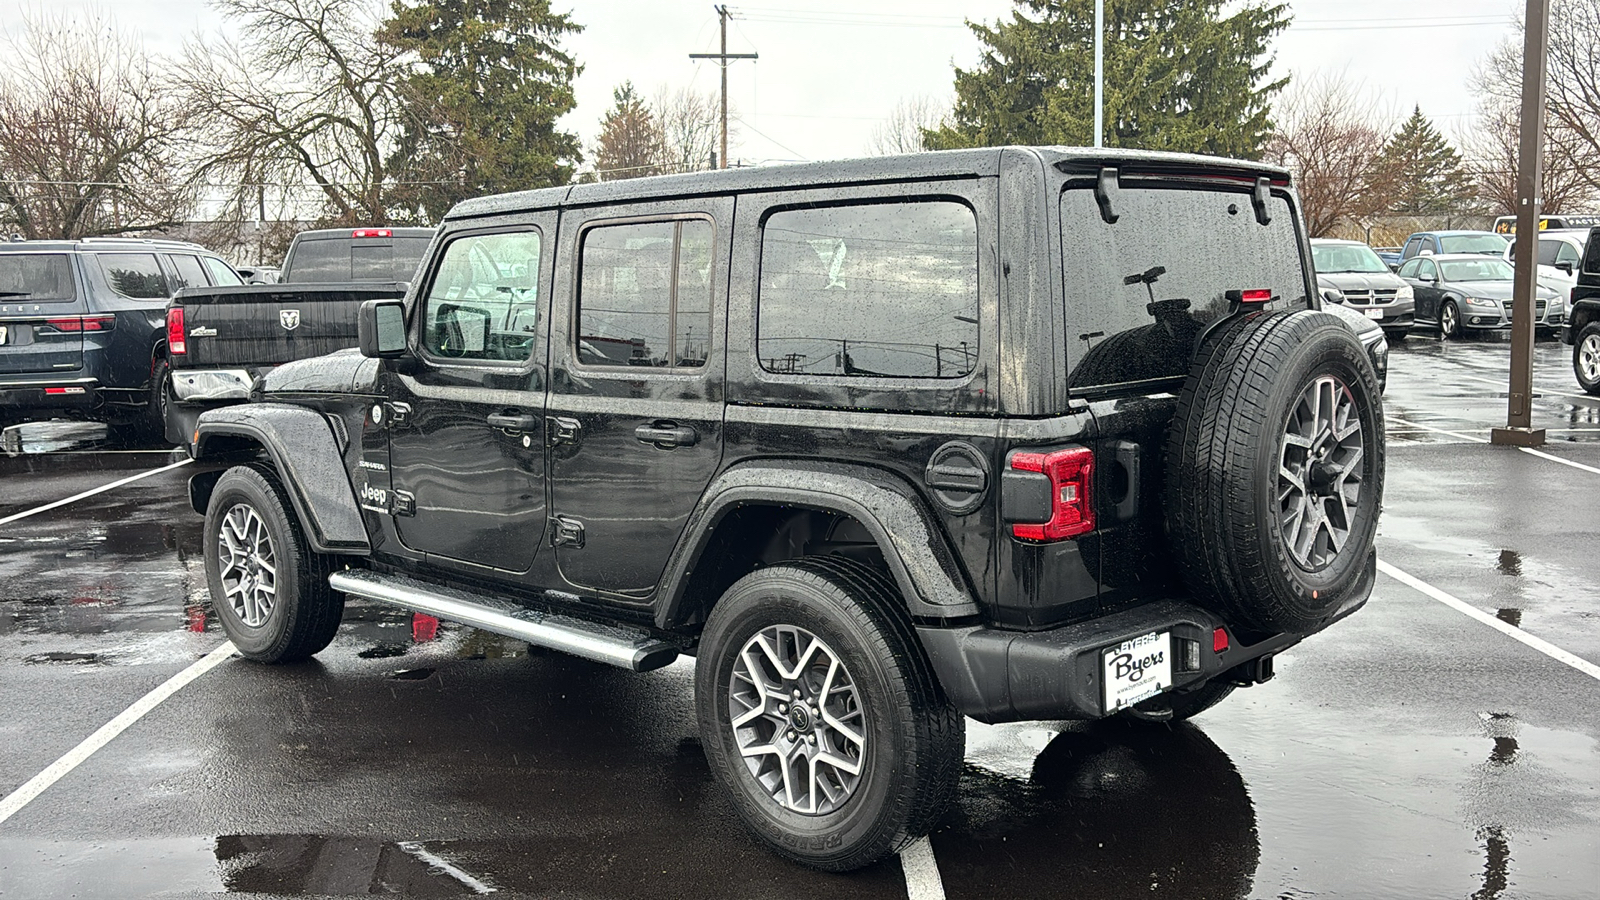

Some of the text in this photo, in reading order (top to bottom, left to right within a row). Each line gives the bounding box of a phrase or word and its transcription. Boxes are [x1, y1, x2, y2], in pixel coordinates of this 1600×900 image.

[361, 482, 387, 506] Jeep
[1120, 631, 1157, 651] BYERS
[1108, 651, 1164, 682] Byers
